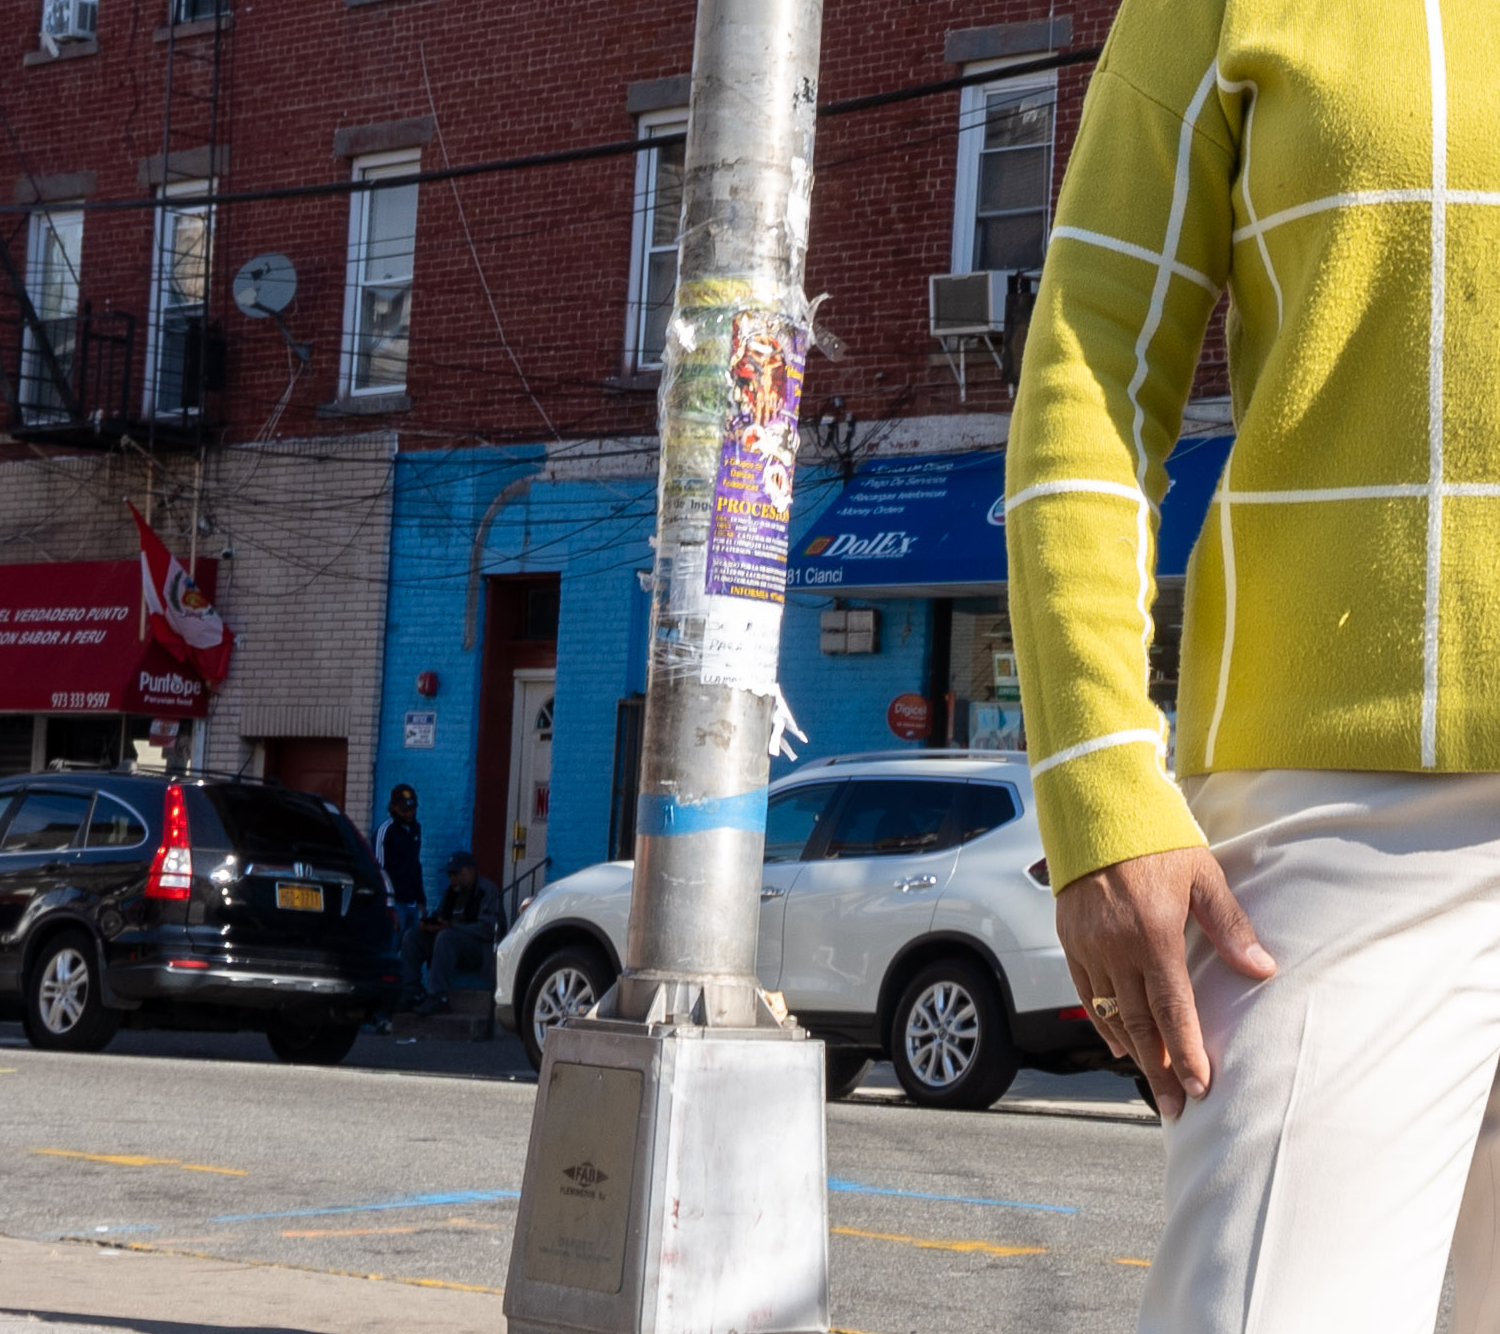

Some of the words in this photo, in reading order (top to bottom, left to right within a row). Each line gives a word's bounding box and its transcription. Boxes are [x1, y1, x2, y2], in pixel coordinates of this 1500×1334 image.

[864, 476, 888, 488] Pago
[889, 476, 904, 487] De
[840, 506, 870, 516] Money
[872, 505, 905, 515] Orders
[822, 531, 918, 557] DolEx
[805, 566, 843, 585] Cianci
[13, 606, 86, 623] VERDADERO
[86, 606, 129, 621] PUNTO
[19, 630, 58, 645] SABOR
[60, 630, 72, 643] A
[71, 629, 107, 644] PERU
[51, 692, 68, 708] 973
[69, 692, 85, 708] 333
[86, 692, 110, 708] 9597
[894, 703, 927, 717] Digicel
